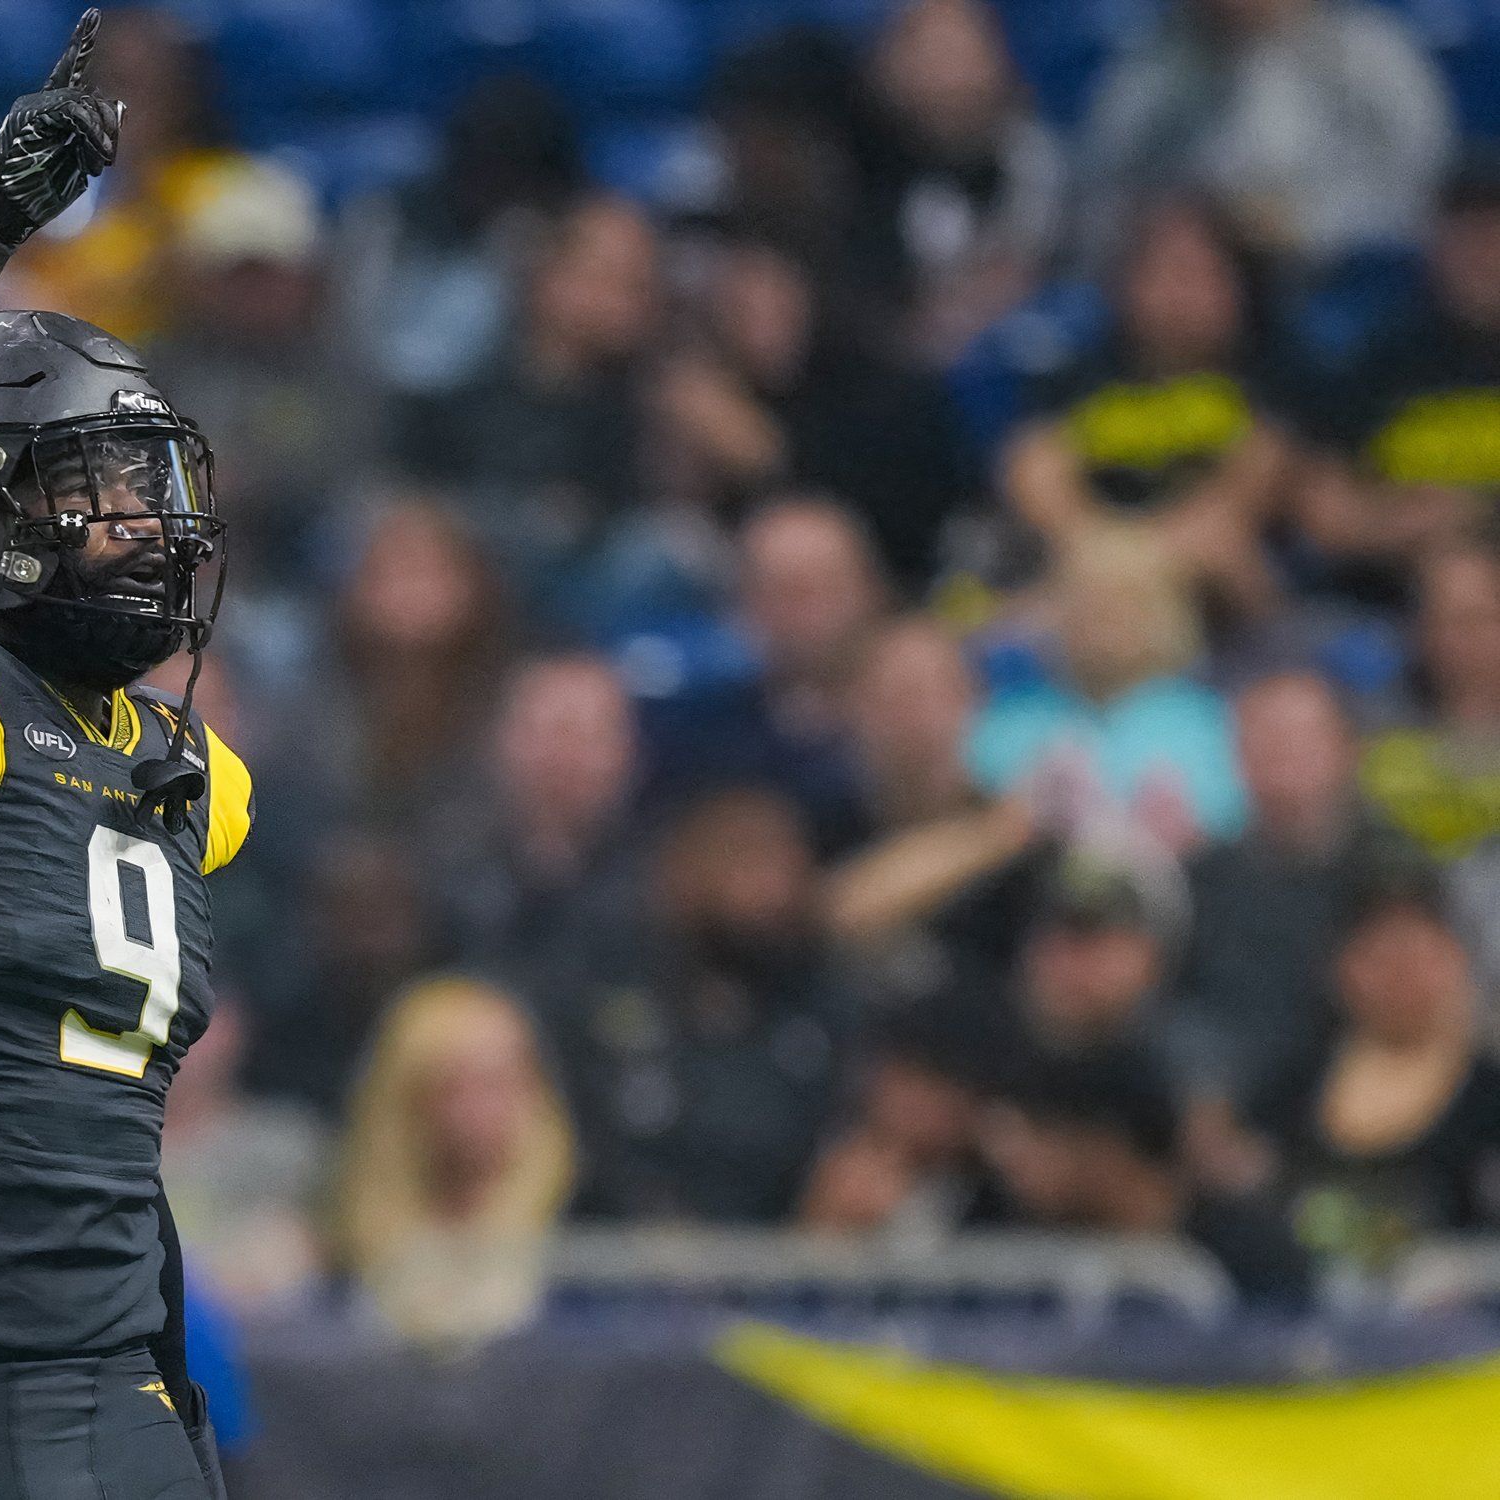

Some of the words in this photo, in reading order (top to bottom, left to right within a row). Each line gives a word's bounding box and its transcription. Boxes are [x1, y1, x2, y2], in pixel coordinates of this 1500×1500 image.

[32, 729, 70, 752] UFL
[53, 772, 93, 793] SAN
[60, 824, 181, 1079] 9
